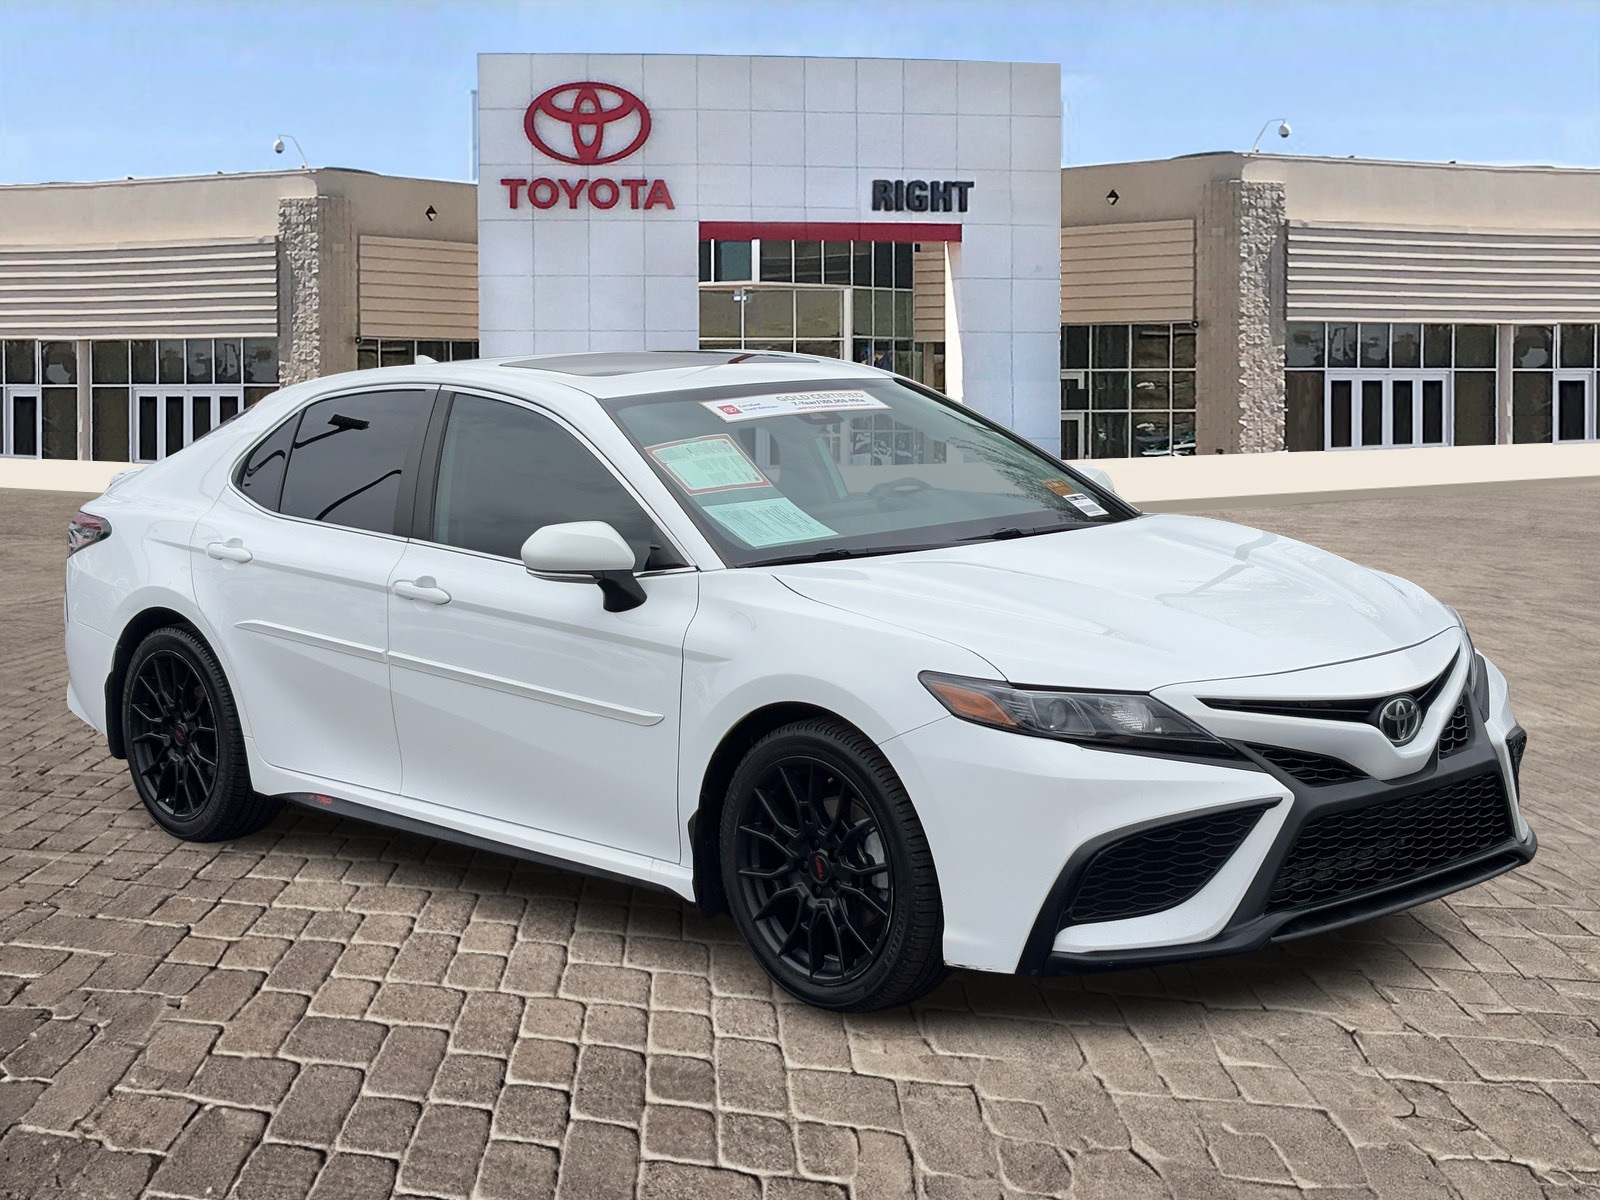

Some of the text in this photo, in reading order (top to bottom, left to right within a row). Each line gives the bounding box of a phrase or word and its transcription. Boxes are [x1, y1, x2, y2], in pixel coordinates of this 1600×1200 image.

[501, 179, 674, 209] TOYOTA
[872, 179, 975, 212] RIGHT
[776, 391, 865, 402] GOLD CERTIFIED
[883, 902, 907, 964] MICHELIN
